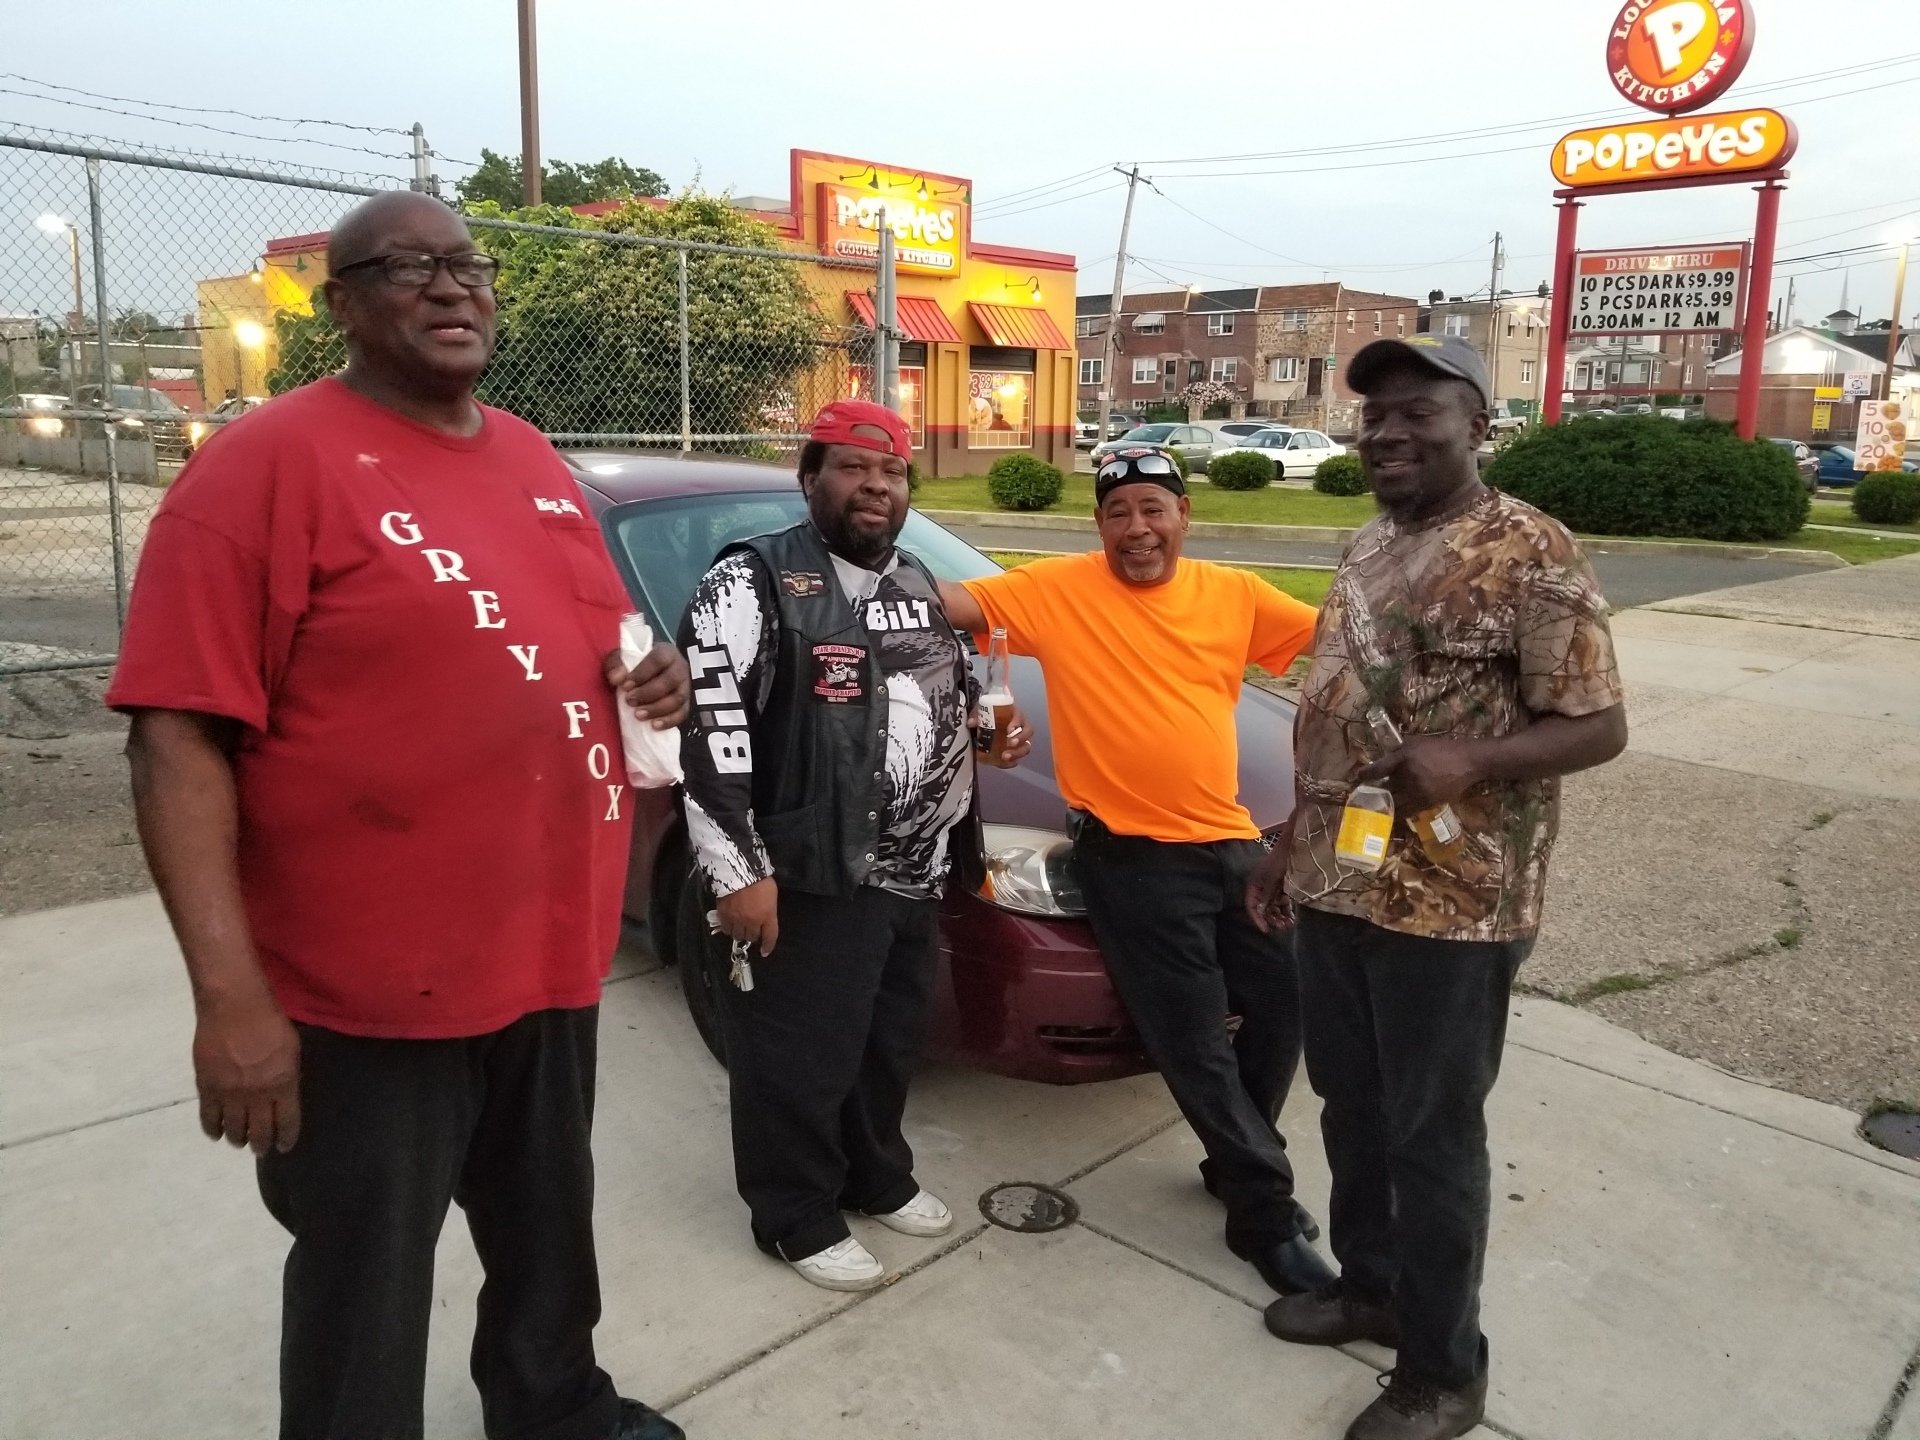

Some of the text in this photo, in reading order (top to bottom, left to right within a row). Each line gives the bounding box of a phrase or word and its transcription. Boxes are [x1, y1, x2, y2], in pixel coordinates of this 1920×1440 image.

[1644, 2, 1707, 73] P
[1614, 52, 1727, 103] KITCHEN
[1605, 252, 1714, 271] DRIVE THRU
[1580, 277, 1597, 292] 10
[1580, 296, 1589, 311] 5
[1664, 312, 1681, 328] 12
[1693, 310, 1720, 327] AM
[1865, 403, 1877, 416] 5
[1864, 421, 1884, 435] 10
[1861, 444, 1886, 458] 20
[380, 511, 543, 681] GREY
[562, 700, 624, 821] FOX
